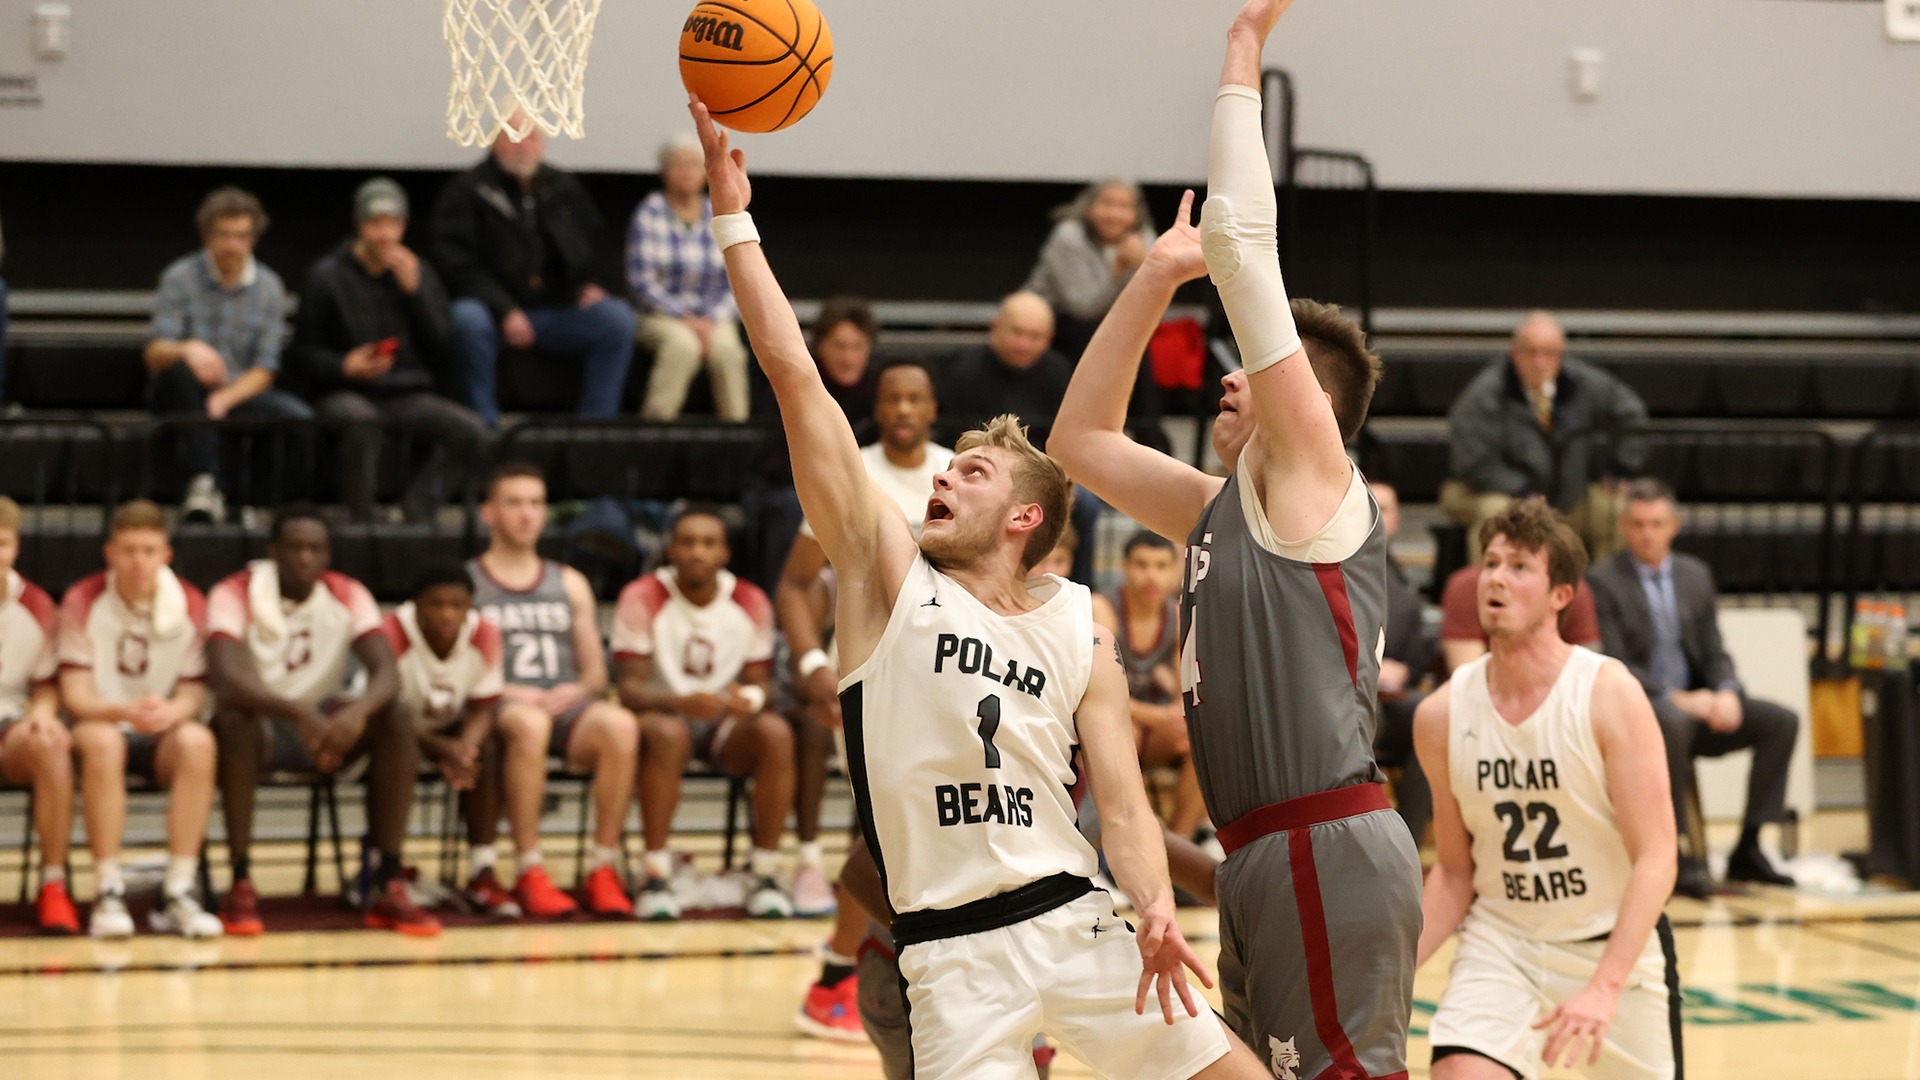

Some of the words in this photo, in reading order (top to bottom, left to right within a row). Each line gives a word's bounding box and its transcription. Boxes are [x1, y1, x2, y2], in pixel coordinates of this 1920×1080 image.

[508, 632, 560, 680] 21
[934, 633, 1046, 699] POLAR
[976, 693, 1001, 769] 1
[1477, 758, 1559, 791] POLAR
[935, 782, 1034, 828] BEARS
[1494, 800, 1569, 863] 22
[1502, 867, 1587, 902] BEARS
